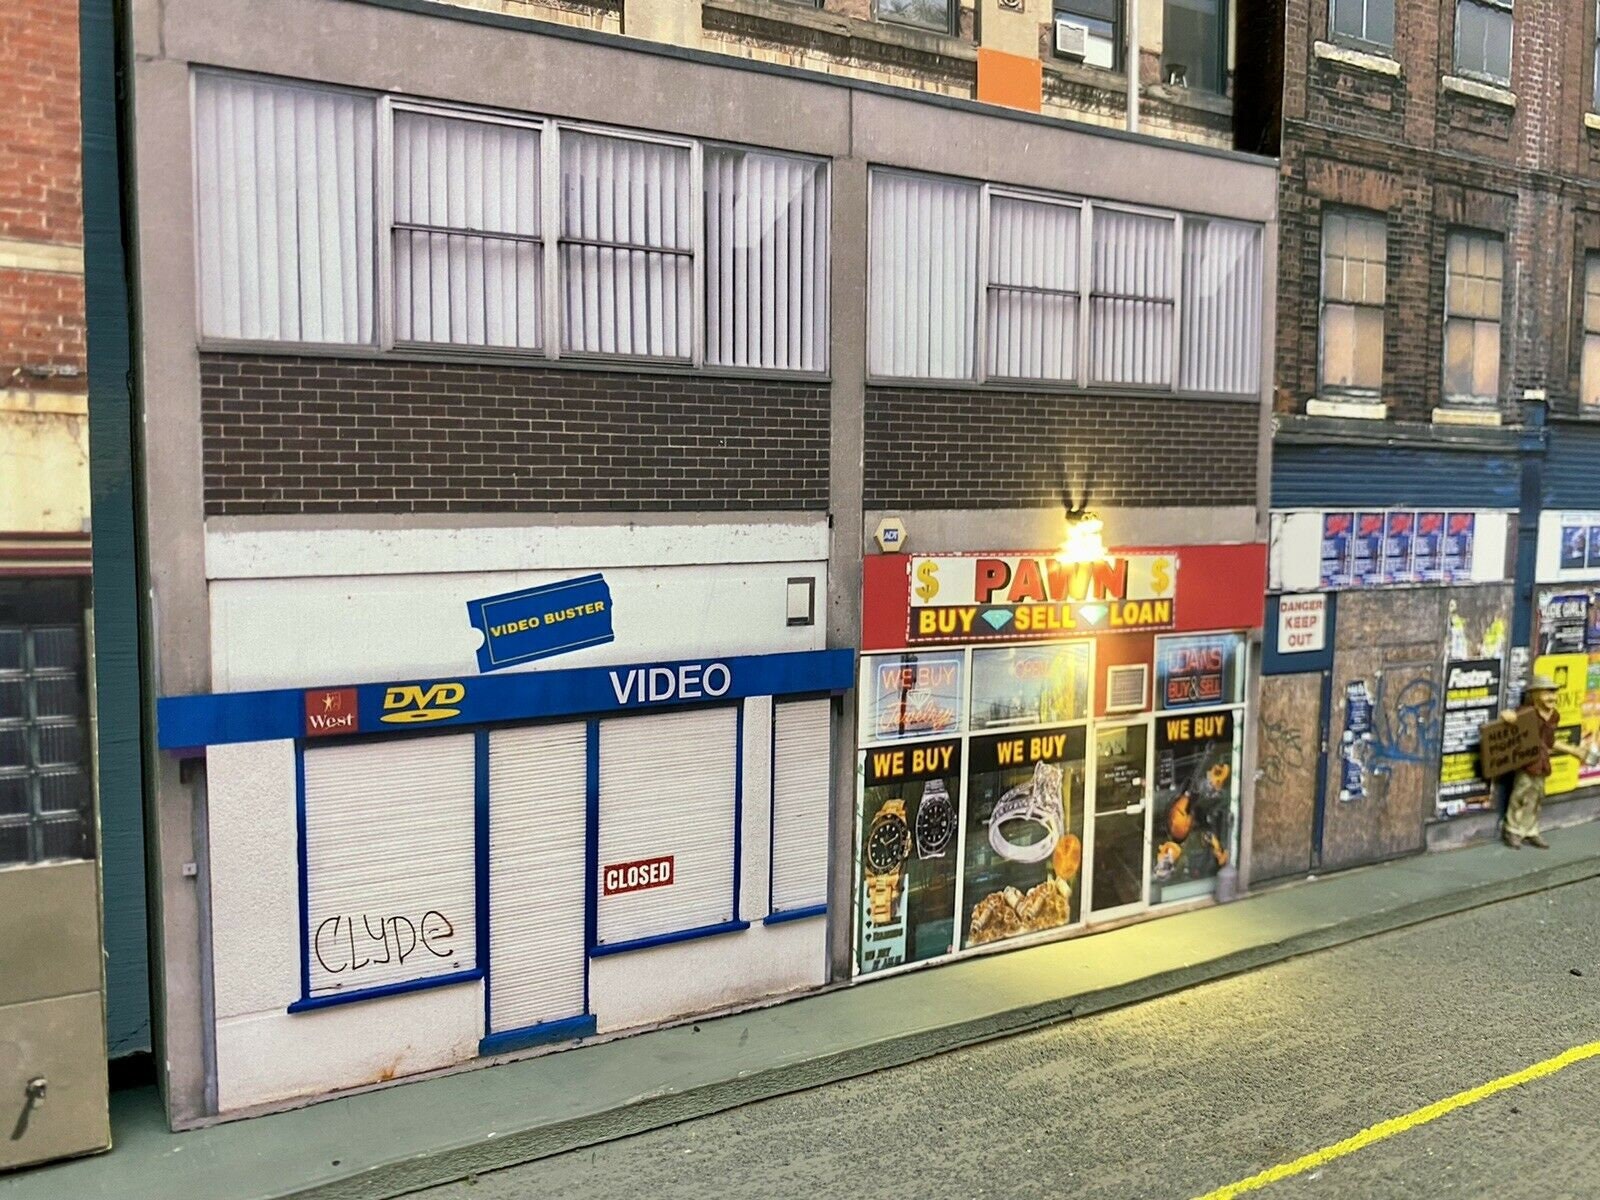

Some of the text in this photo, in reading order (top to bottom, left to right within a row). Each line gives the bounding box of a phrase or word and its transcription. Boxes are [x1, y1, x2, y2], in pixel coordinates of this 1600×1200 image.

[884, 530, 899, 541] ADT
[974, 558, 1128, 603] PAWN
[490, 601, 605, 638] VIDEO BUSTER
[918, 600, 1169, 635] BUY SELL LOAN
[1280, 600, 1322, 613] DANGER
[1285, 616, 1317, 630] KEEP
[1288, 633, 1313, 647] OUT
[609, 663, 731, 705] VIDEO
[882, 665, 955, 690] WE BUY
[1168, 682, 1190, 699] BUY
[1200, 678, 1222, 696] SELL
[383, 683, 465, 711] DVD
[309, 712, 355, 731] West
[1167, 715, 1225, 741] WE BUY
[873, 745, 953, 778] WE BUY
[997, 734, 1066, 765] WE BUY
[606, 861, 671, 890] CLOSED
